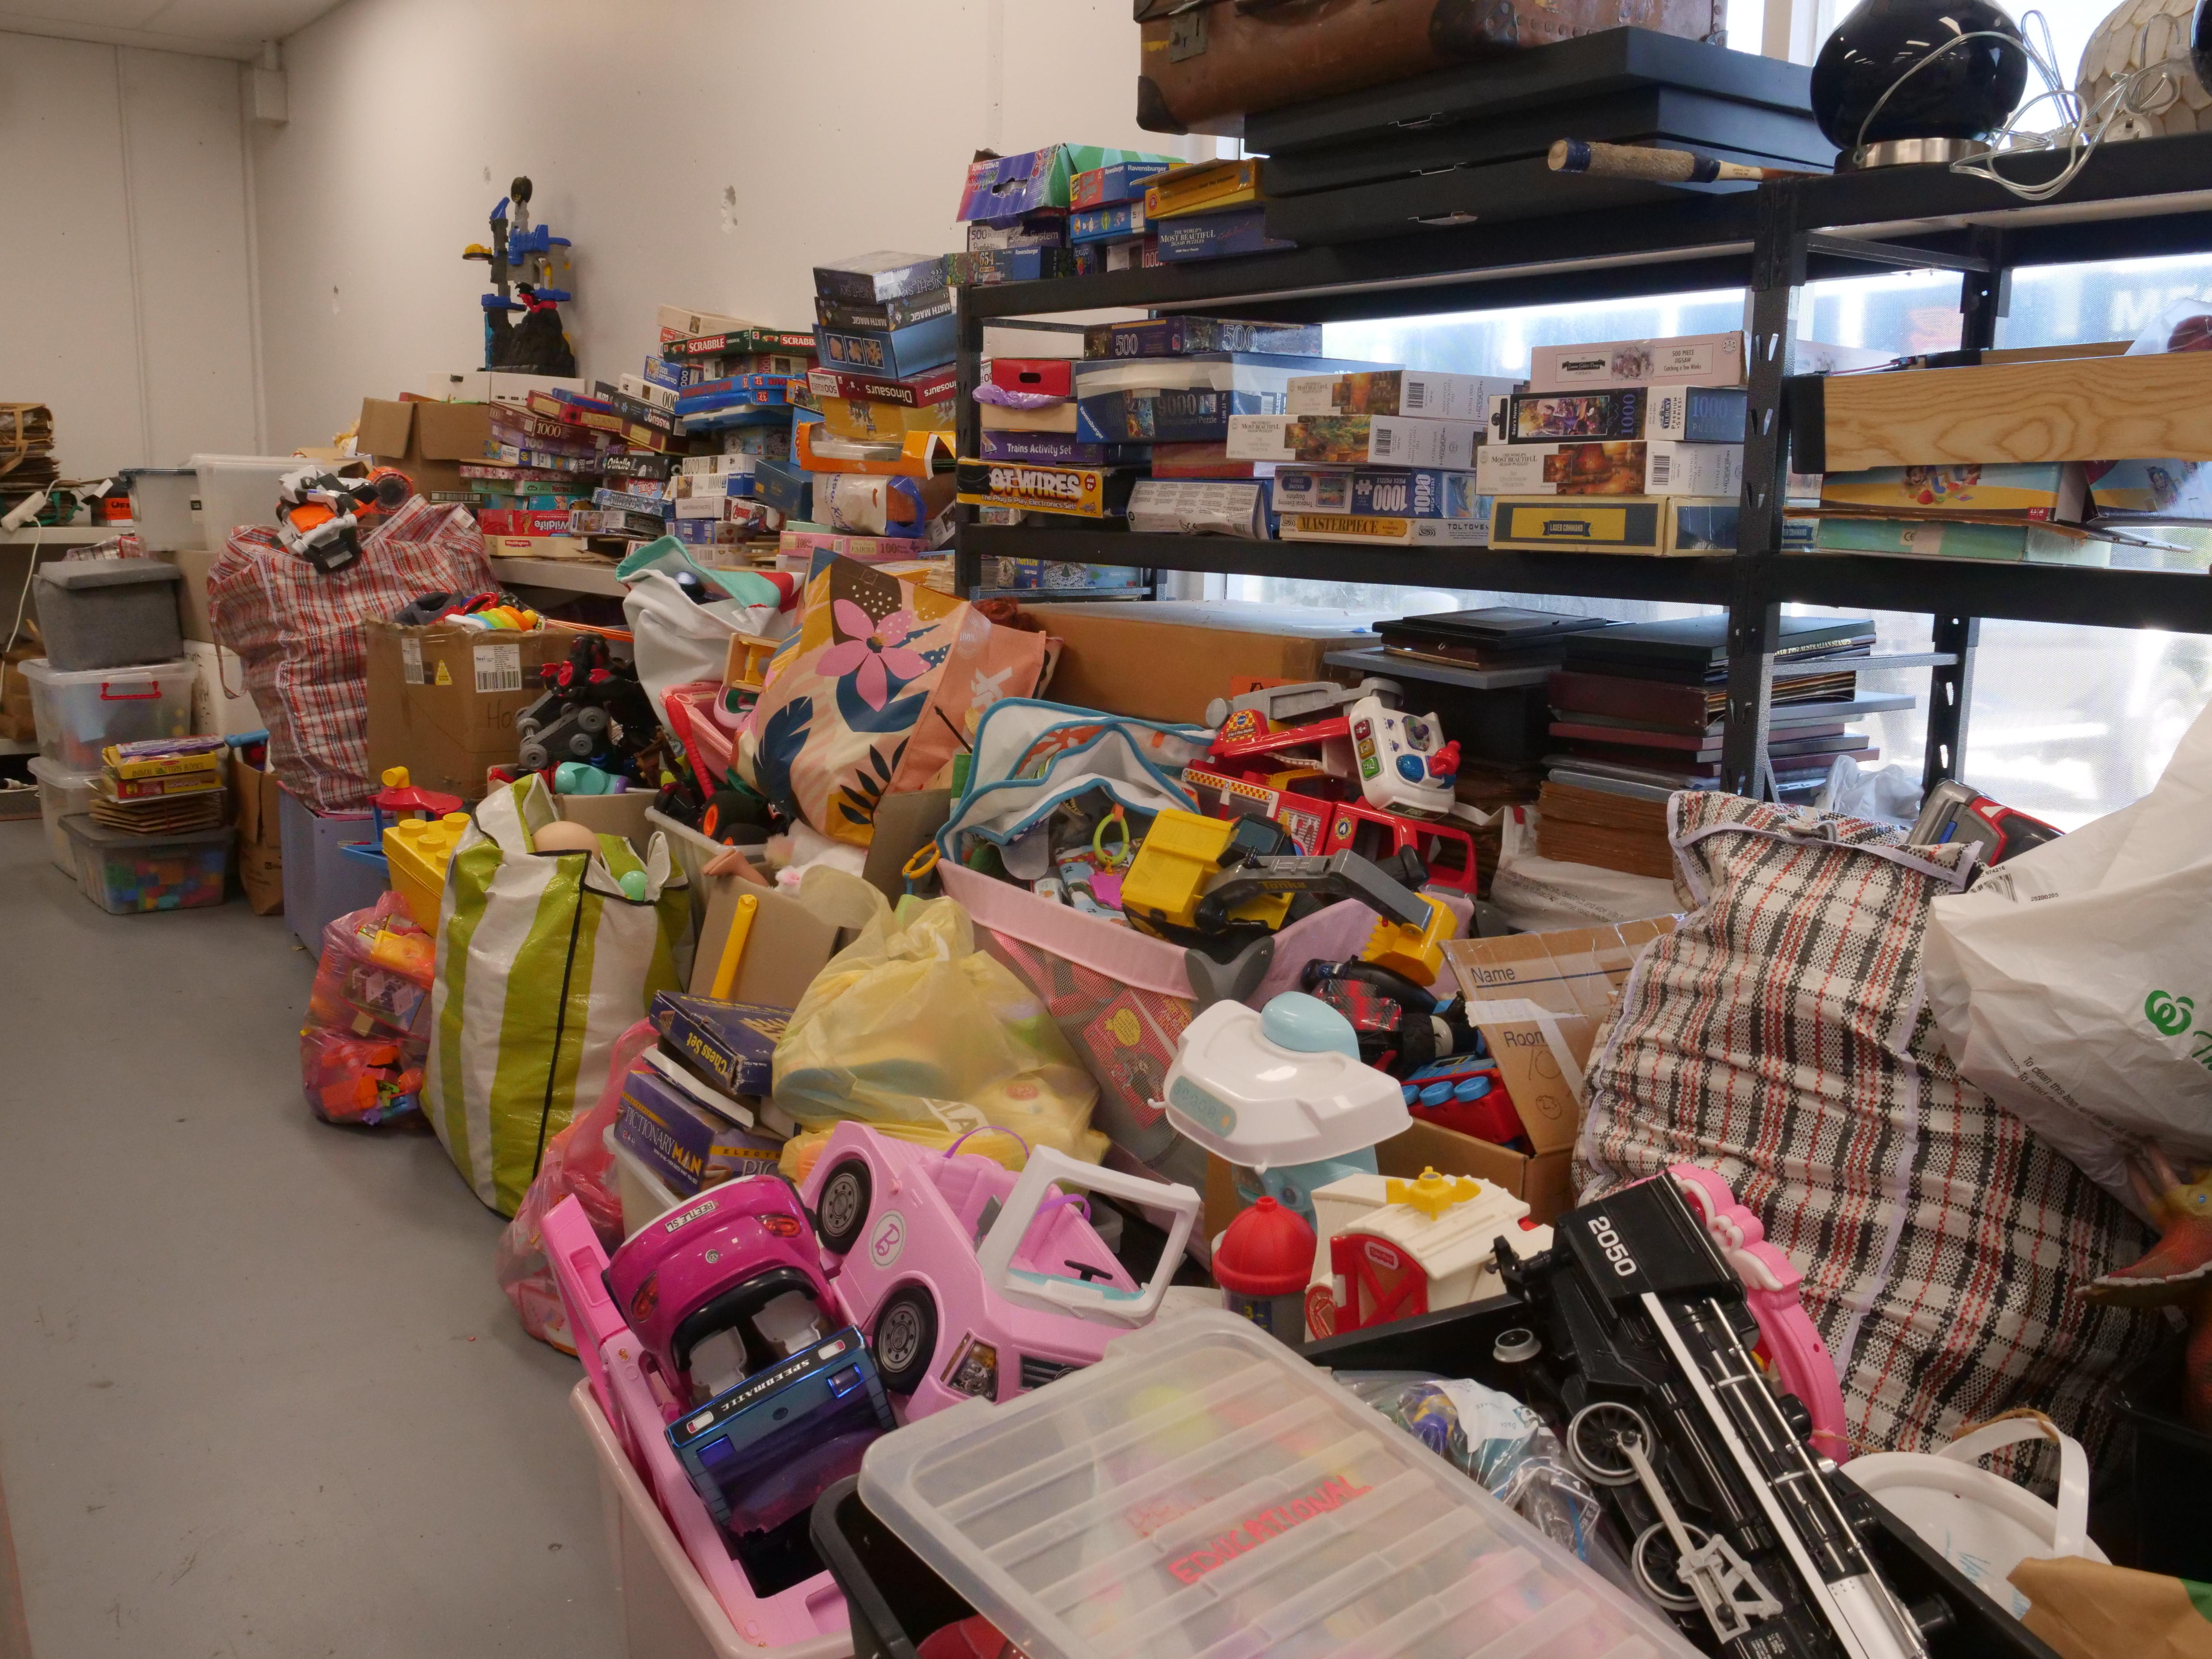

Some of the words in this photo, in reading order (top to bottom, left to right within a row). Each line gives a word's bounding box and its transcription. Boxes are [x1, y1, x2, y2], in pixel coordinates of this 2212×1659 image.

[971, 230, 987, 240] 500
[1030, 230, 1058, 243] System
[1180, 230, 1216, 241] BEAUTIFUL
[979, 252, 994, 265] 654
[910, 307, 930, 321] MAGIC
[931, 303, 951, 315] MATH
[782, 336, 816, 346] SCRABB
[1115, 333, 1138, 355] 500
[1222, 324, 1257, 351] 500
[688, 338, 725, 353] SCRABBLE
[865, 384, 913, 403] Dinosaurs
[924, 380, 956, 396] inosaurs
[1198, 415, 1217, 424] Puzzle
[1621, 394, 1636, 435] 1000
[536, 422, 561, 438] 1000
[1079, 405, 1104, 440] Ravensburger
[1007, 443, 1028, 453] Trains
[1030, 444, 1058, 457] Activity
[1060, 445, 1071, 455] Set
[607, 457, 631, 470] Othello
[684, 459, 699, 475] 1000
[708, 476, 722, 489] 1000
[1018, 469, 1083, 500] WIRES
[1373, 484, 1408, 511] 1000
[1414, 474, 1431, 515] 1000
[1014, 498, 1027, 506] Play
[1029, 499, 1062, 508] Electronics
[1278, 499, 1294, 507] Evening
[1296, 499, 1313, 508] Tropical
[534, 520, 569, 531] Wildlife
[1300, 516, 1379, 534] MASTERPIECE
[1563, 524, 1583, 532] COMMAND
[880, 543, 897, 553] 100
[2030, 892, 2059, 902] 20200205
[1471, 967, 1516, 983] Name
[686, 1032, 703, 1055] Set
[701, 1040, 728, 1075] Chess
[2017, 1071, 2028, 1083] To
[2023, 1055, 2033, 1067] To
[2032, 1064, 2051, 1086] clean
[2050, 1081, 2066, 1096] this
[626, 1106, 675, 1155] PICTIONARY
[671, 1141, 703, 1177] MAN
[683, 1201, 714, 1222] BEETLE
[667, 1219, 679, 1232] SL
[1587, 1215, 1637, 1277] 2050
[721, 1359, 810, 1412] SPEEDMATIC
[1168, 1475, 1373, 1585] EDUCATIONAL
